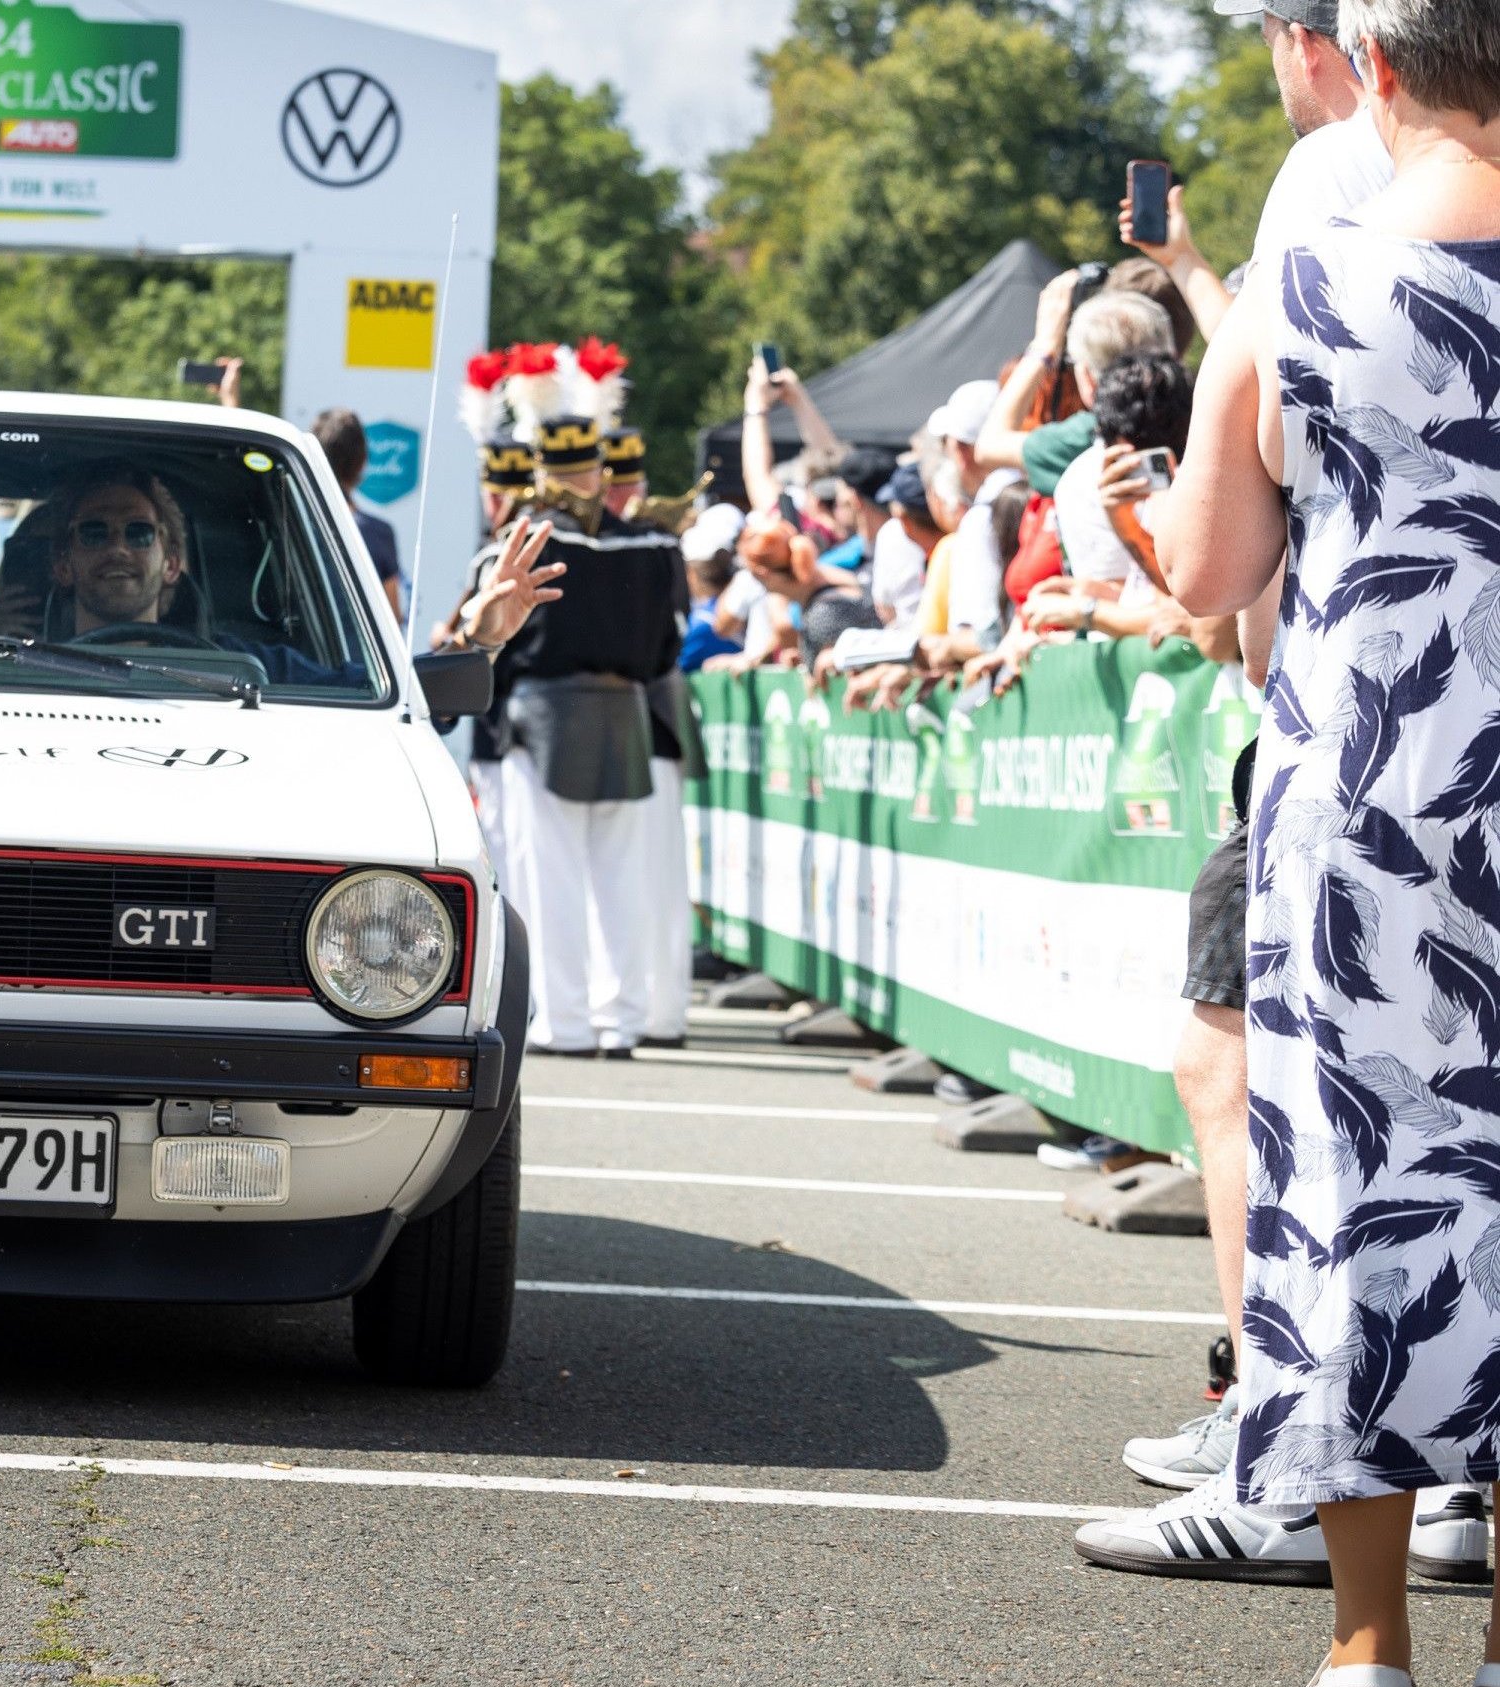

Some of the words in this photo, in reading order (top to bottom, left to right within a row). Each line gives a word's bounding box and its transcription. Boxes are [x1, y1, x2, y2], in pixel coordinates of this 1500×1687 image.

[3, 119, 78, 148] AUTO
[350, 281, 436, 314] ADAC
[118, 906, 208, 947] GTI
